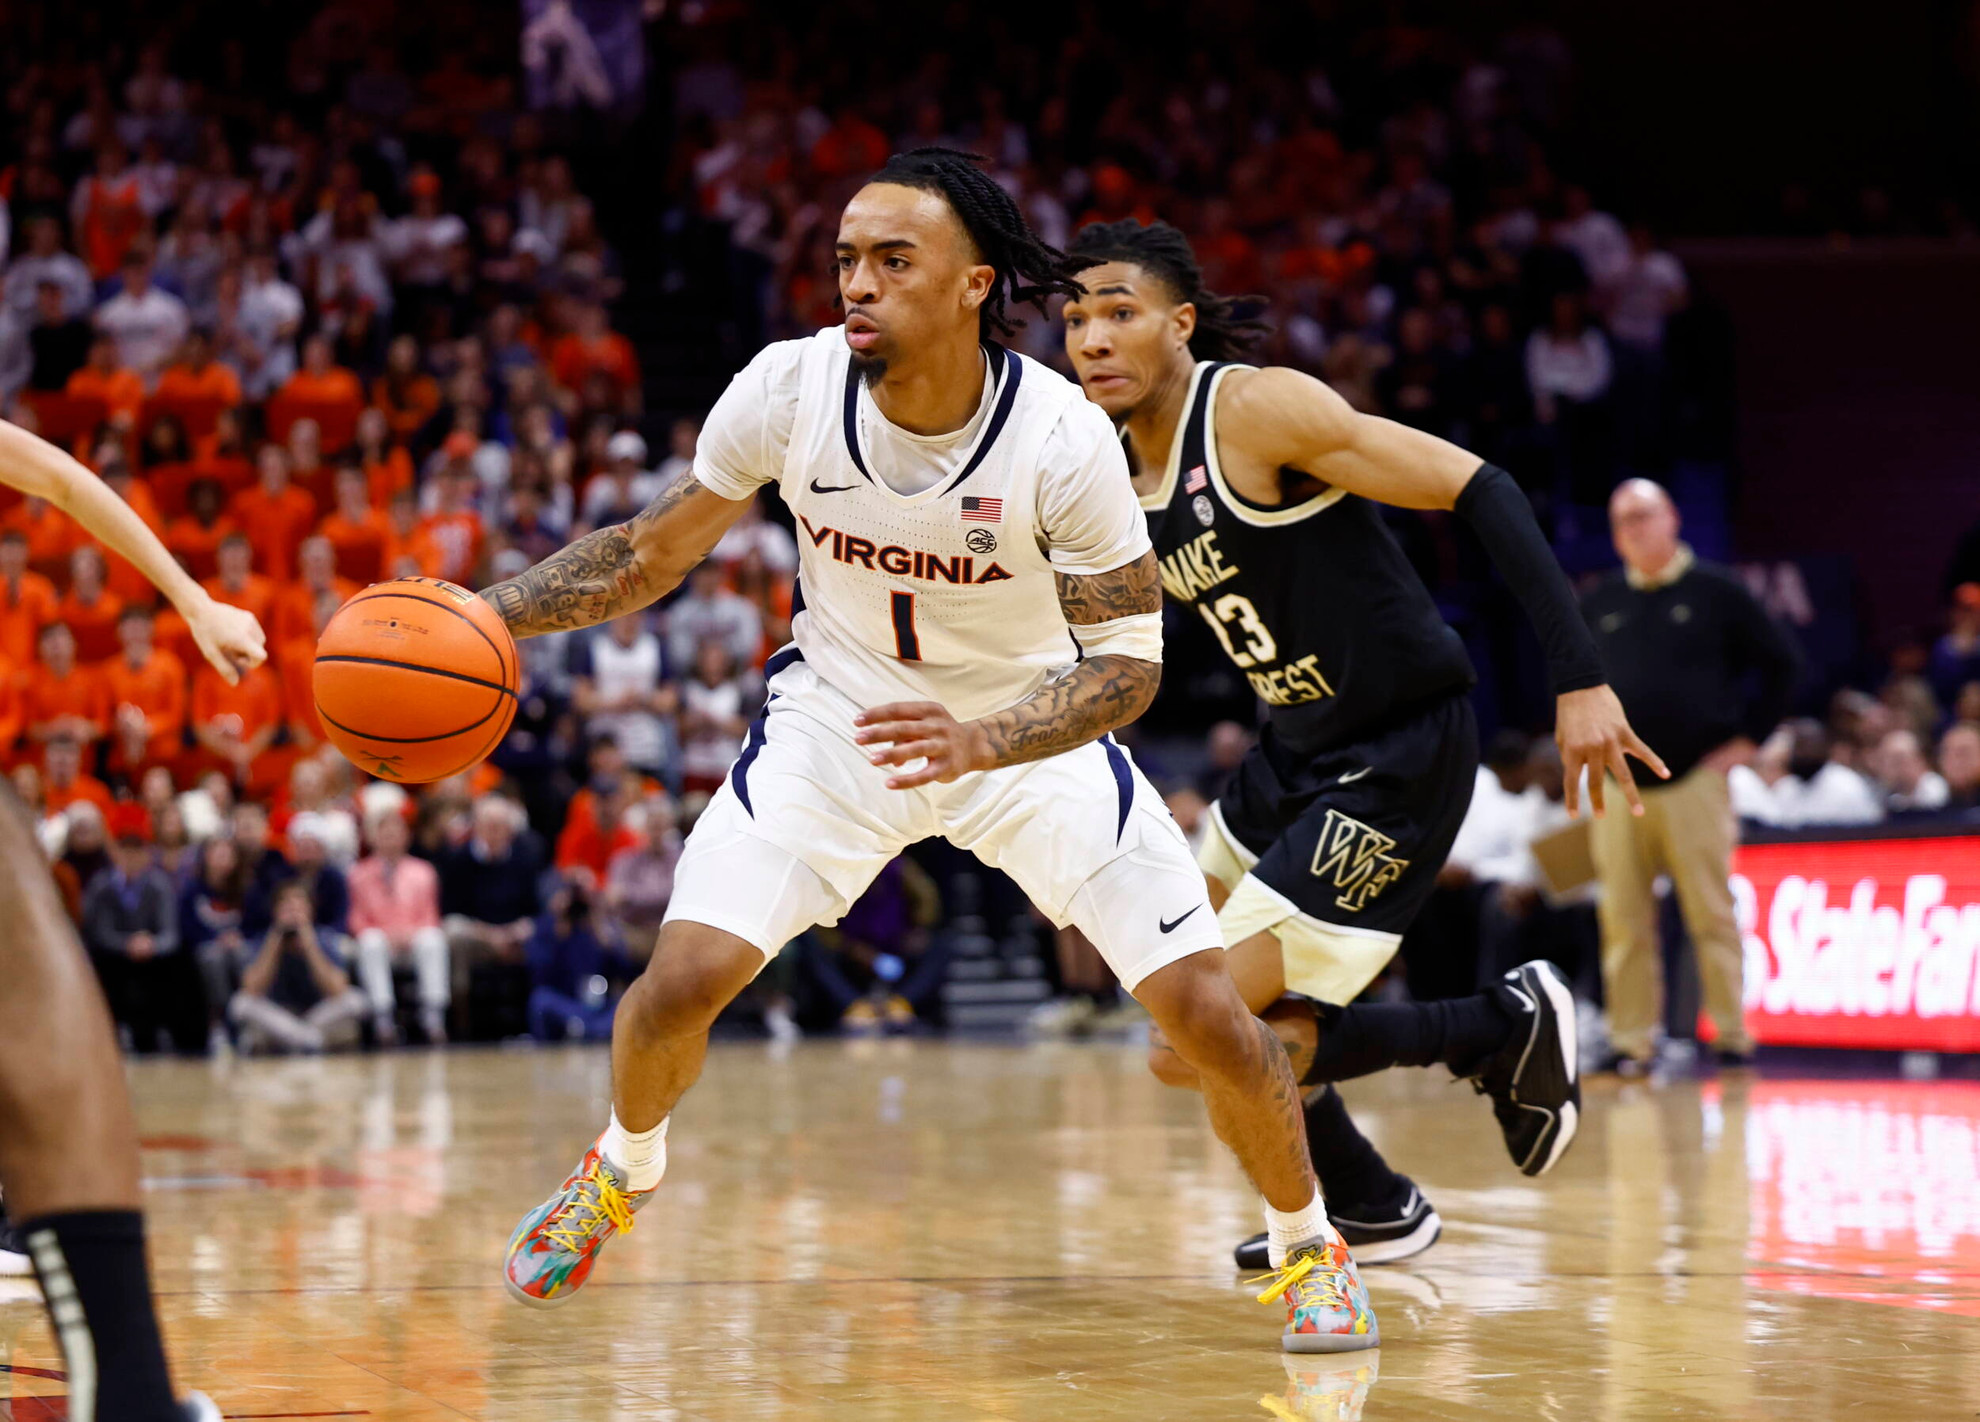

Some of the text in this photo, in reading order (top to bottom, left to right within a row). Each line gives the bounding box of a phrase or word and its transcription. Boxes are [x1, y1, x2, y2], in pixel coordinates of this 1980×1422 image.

[798, 513, 1015, 584] VIRGINIA
[1158, 529, 1239, 601] WAKE
[889, 589, 923, 661] 1
[1198, 593, 1277, 668] 13
[1246, 654, 1336, 705] REST
